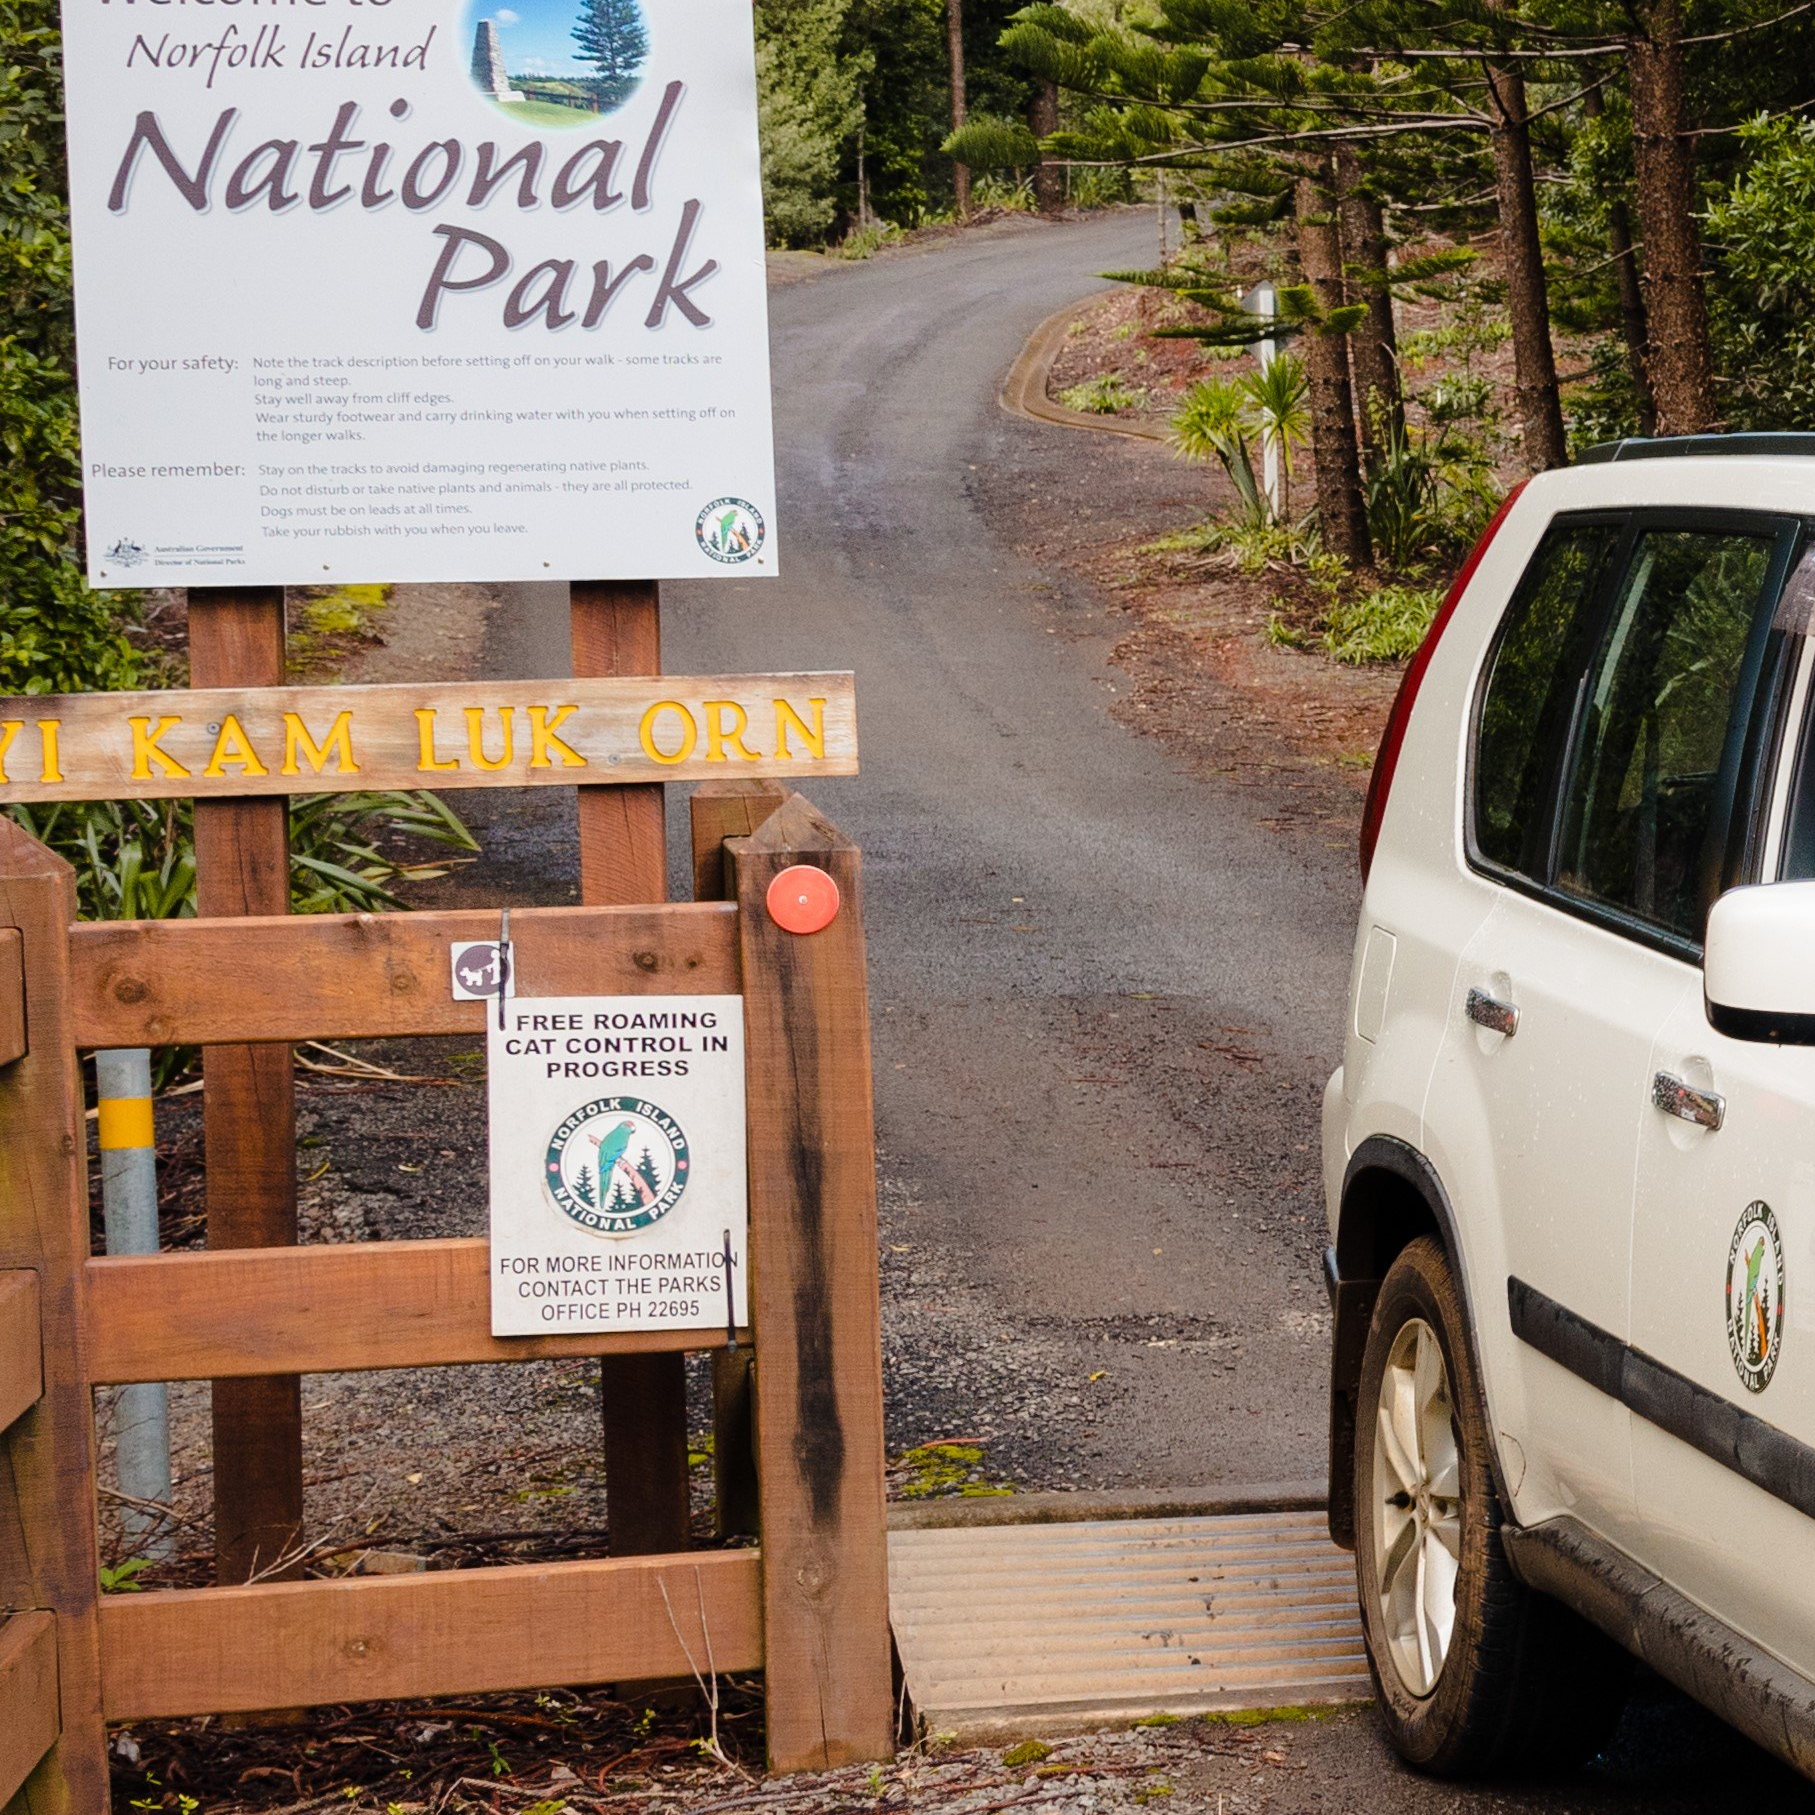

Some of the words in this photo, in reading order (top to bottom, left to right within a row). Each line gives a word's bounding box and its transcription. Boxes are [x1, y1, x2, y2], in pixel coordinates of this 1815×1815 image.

[127, 24, 285, 89] Norfolk
[300, 25, 437, 70] Island
[106, 80, 686, 211] National
[416, 198, 719, 330] Park
[108, 356, 135, 371] For
[138, 359, 177, 375] your
[182, 355, 238, 373] safety:
[253, 357, 284, 369] Note
[287, 357, 309, 368] the
[312, 356, 344, 368] track
[346, 356, 418, 370] description
[422, 355, 462, 367] before
[464, 354, 510, 370] setting
[514, 354, 531, 365] off
[534, 357, 551, 365] on
[553, 354, 582, 369] your
[585, 354, 614, 366] walk
[626, 356, 659, 365] some
[662, 354, 699, 367] tracks
[703, 356, 722, 365] are
[253, 375, 283, 389] long
[285, 376, 310, 388] and
[313, 376, 352, 389] steep.
[254, 393, 282, 406] Stay
[285, 393, 312, 405] well
[315, 396, 349, 406] away
[352, 392, 383, 404] from
[386, 392, 411, 403] cliff
[414, 392, 454, 405] edges.
[255, 413, 289, 424] Wear
[293, 411, 333, 425] sturdy
[336, 410, 395, 422] footwear
[398, 410, 422, 421] and
[425, 413, 457, 424] carry
[460, 410, 513, 423] drinking
[516, 410, 553, 420] water
[555, 409, 584, 420] with
[588, 410, 610, 423] you
[613, 408, 650, 419] when
[652, 408, 696, 422] setting
[699, 406, 717, 418] off
[720, 409, 735, 418] on
[256, 430, 278, 442] the
[281, 430, 322, 443] longer
[325, 429, 365, 441] walks.
[92, 463, 146, 478] Please
[151, 461, 245, 477] remember:
[258, 464, 285, 478] Stay
[288, 466, 304, 475] on
[307, 464, 328, 475] the
[331, 463, 367, 475] tracks
[370, 464, 383, 474] to
[386, 463, 419, 474] avoid
[423, 462, 485, 475] damaging
[488, 462, 566, 474] regenerating
[570, 460, 607, 471] native
[610, 460, 649, 473] plants.
[260, 485, 278, 496] Do
[281, 486, 302, 496] not
[306, 484, 349, 495] disturb
[352, 486, 365, 494] or
[368, 483, 394, 494] take
[398, 483, 435, 494] native
[439, 482, 476, 495] plants
[479, 482, 502, 492] and
[505, 481, 552, 492] animals
[562, 481, 589, 493] they
[592, 482, 611, 491] are
[614, 480, 627, 490] all
[631, 479, 692, 492] protected.
[261, 506, 293, 520] Dogs
[296, 507, 327, 516] must
[331, 505, 346, 516] be
[349, 507, 365, 515] on
[369, 504, 401, 515] leads
[404, 505, 416, 514] at
[418, 503, 432, 514] all
[435, 504, 472, 514] times.
[261, 526, 290, 537] Take
[292, 529, 321, 540] your
[324, 525, 371, 536] rubbish
[374, 524, 401, 535] with
[404, 527, 428, 539] you
[430, 522, 467, 535] when
[468, 526, 490, 537] you
[493, 523, 528, 534] leave.
[127, 710, 360, 779] KAM
[413, 705, 588, 771] LUK
[639, 698, 827, 765] ORN
[517, 1015, 583, 1031] FREE
[594, 1012, 716, 1029] ROAMING
[506, 1038, 556, 1055] CAT
[566, 1037, 692, 1054] CONTROL
[703, 1036, 727, 1051] IN
[547, 1060, 689, 1078] PROGRESS
[551, 1098, 621, 1150] NORFOLK
[635, 1102, 685, 1150] ISLAND
[554, 1187, 637, 1230] NATIONAL
[649, 1181, 684, 1220] PARK
[1729, 1202, 1765, 1265] NORFOLK
[1766, 1212, 1784, 1286] ISLAND
[501, 1258, 539, 1274] FOR
[547, 1256, 601, 1273] MORE
[519, 1279, 608, 1298] CONTACT
[615, 1278, 651, 1294] THE
[659, 1276, 721, 1293] PARKS
[542, 1303, 609, 1321] OFFICE
[618, 1302, 641, 1318] PH
[649, 1300, 699, 1317] 22695
[1727, 1318, 1759, 1389] NATIONAL
[1763, 1332, 1781, 1381] PARK
